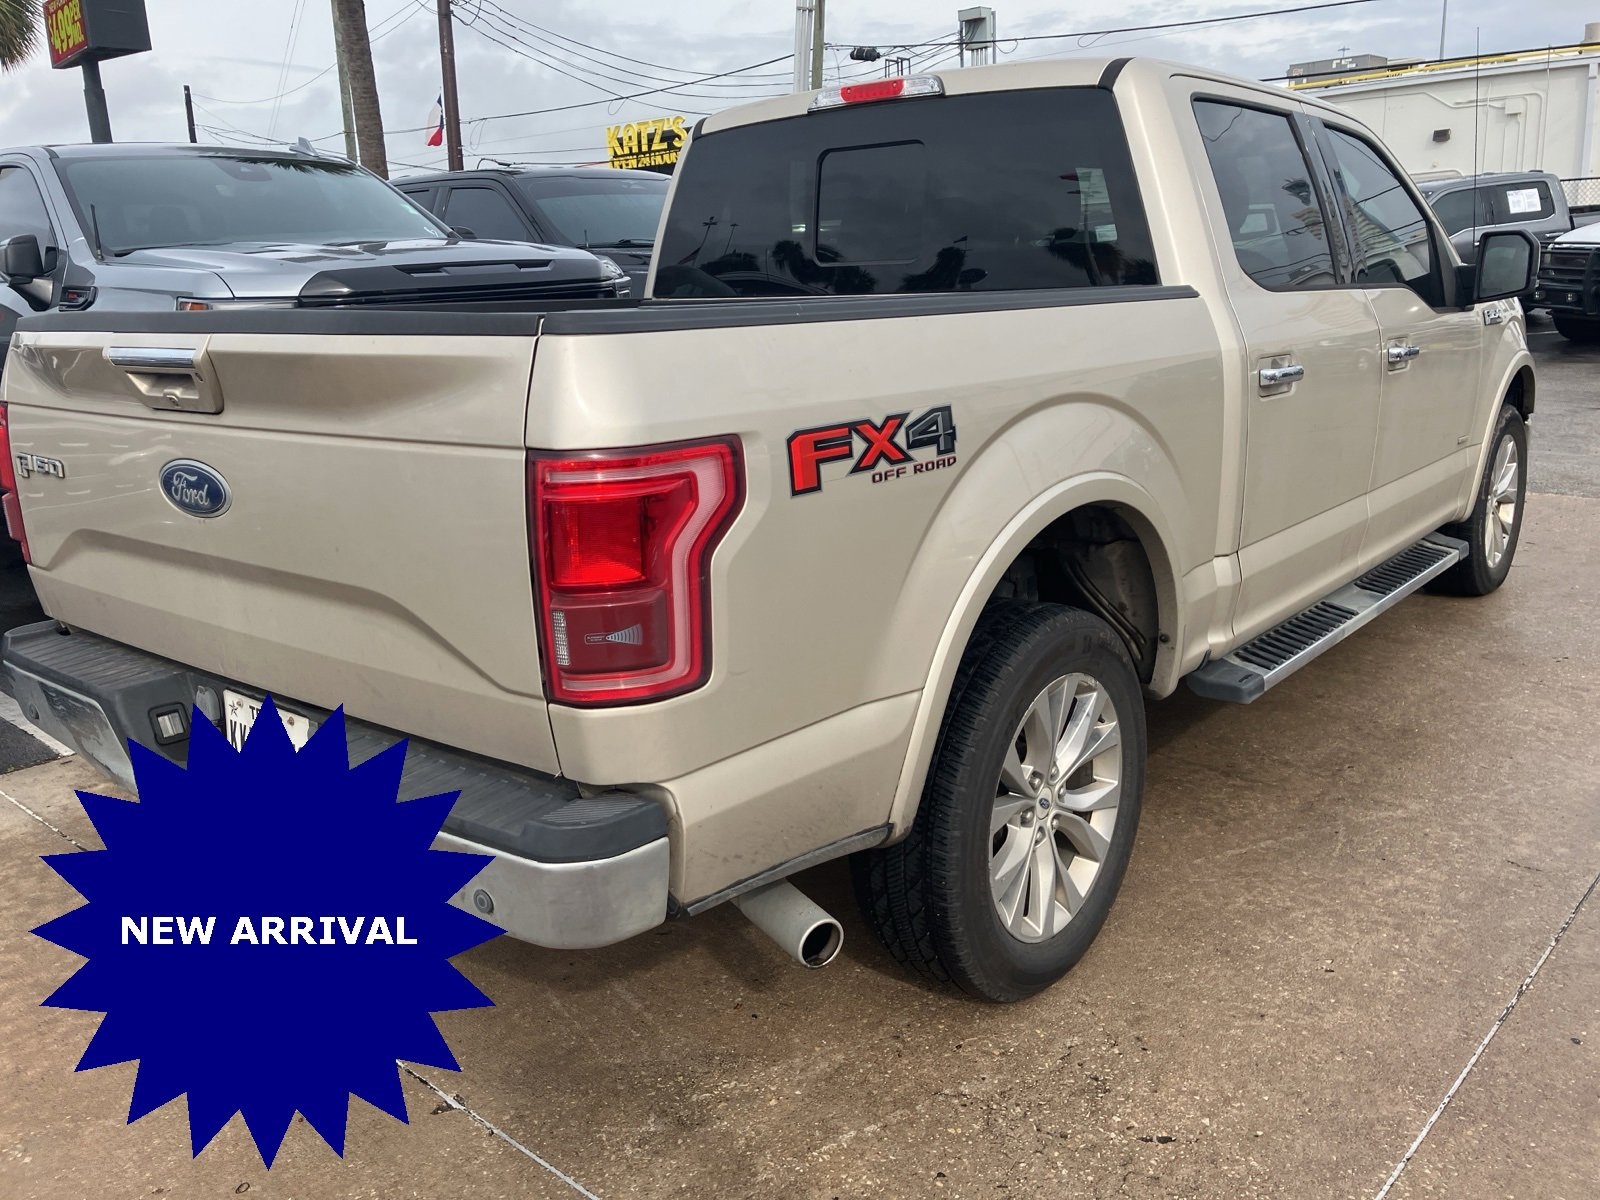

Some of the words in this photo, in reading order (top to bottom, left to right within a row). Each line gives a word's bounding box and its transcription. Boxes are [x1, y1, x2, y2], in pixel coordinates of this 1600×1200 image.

[48, 4, 74, 54] $499
[606, 115, 688, 156] KATZ'S
[786, 404, 957, 497] FX4
[871, 466, 907, 484] OFF
[913, 455, 957, 475] ROAD
